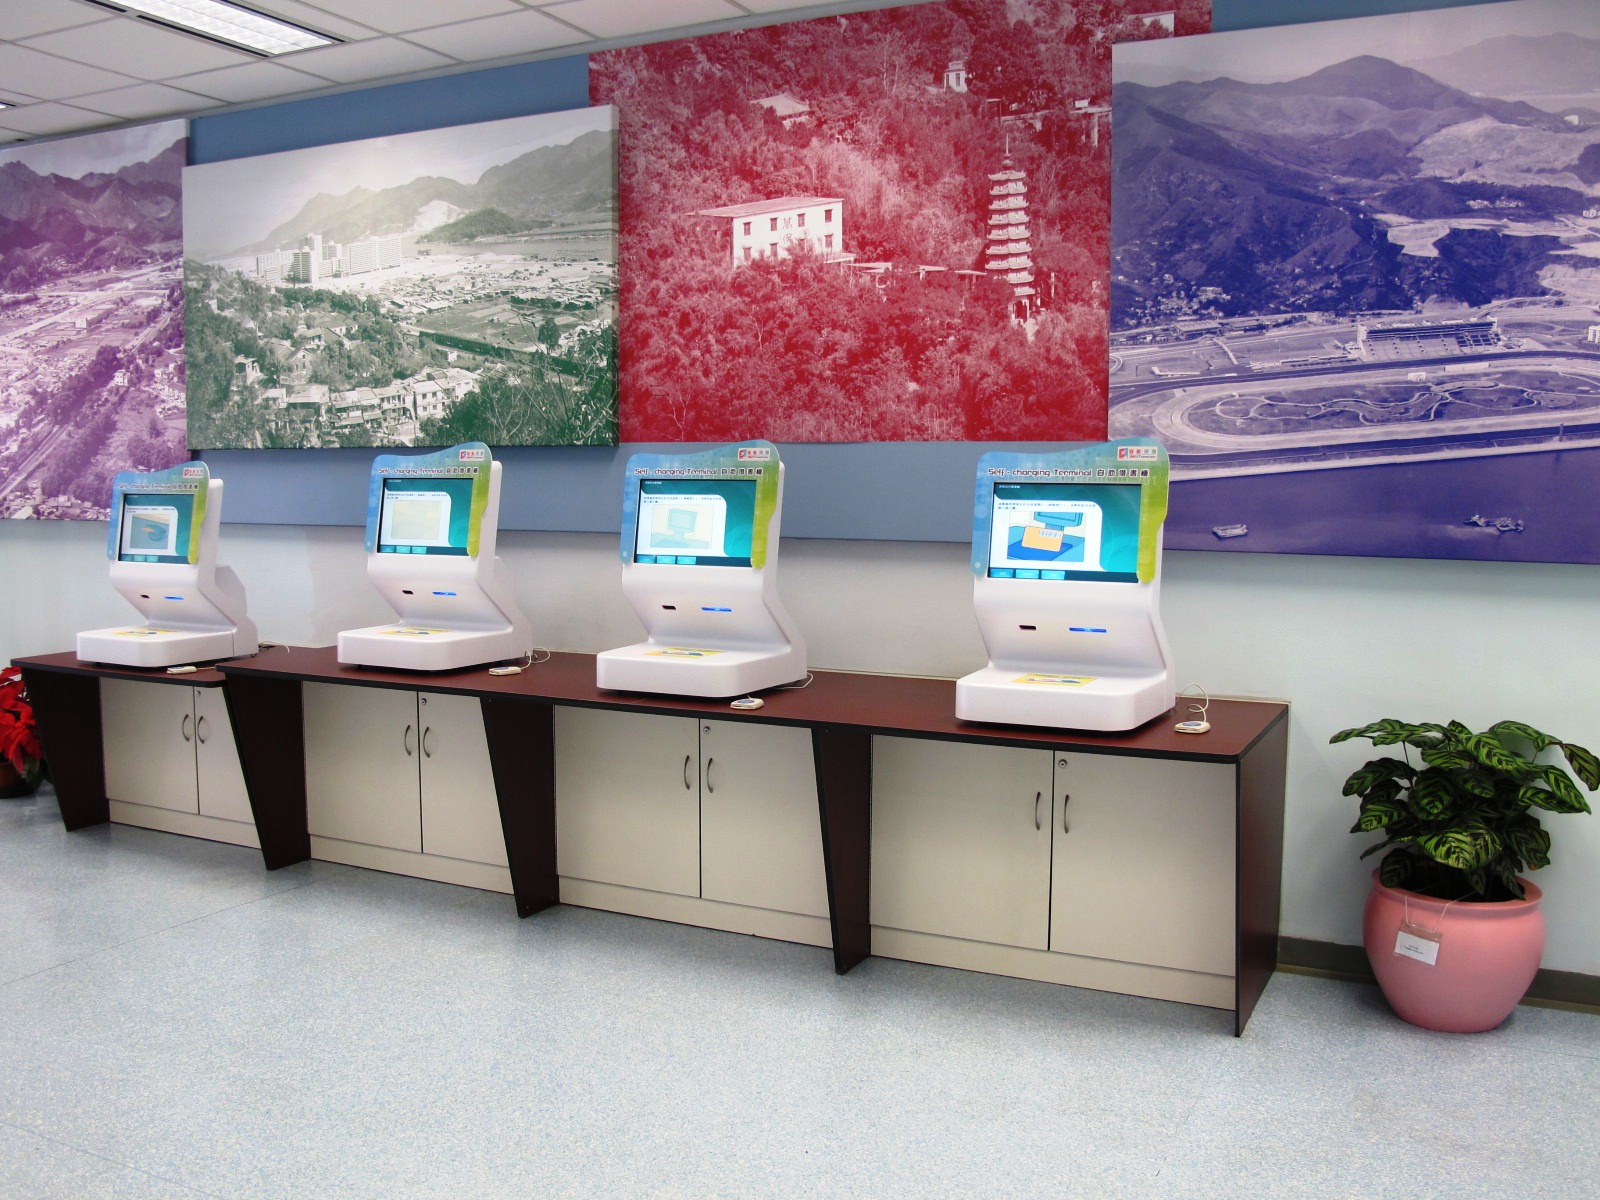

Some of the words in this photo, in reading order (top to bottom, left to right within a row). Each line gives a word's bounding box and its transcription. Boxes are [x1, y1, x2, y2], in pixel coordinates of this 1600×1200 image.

[635, 468, 649, 476] Self
[654, 468, 685, 476] charging
[988, 468, 1004, 477] Self
[1012, 468, 1050, 477] charging
[1053, 468, 1092, 476] Terminal
